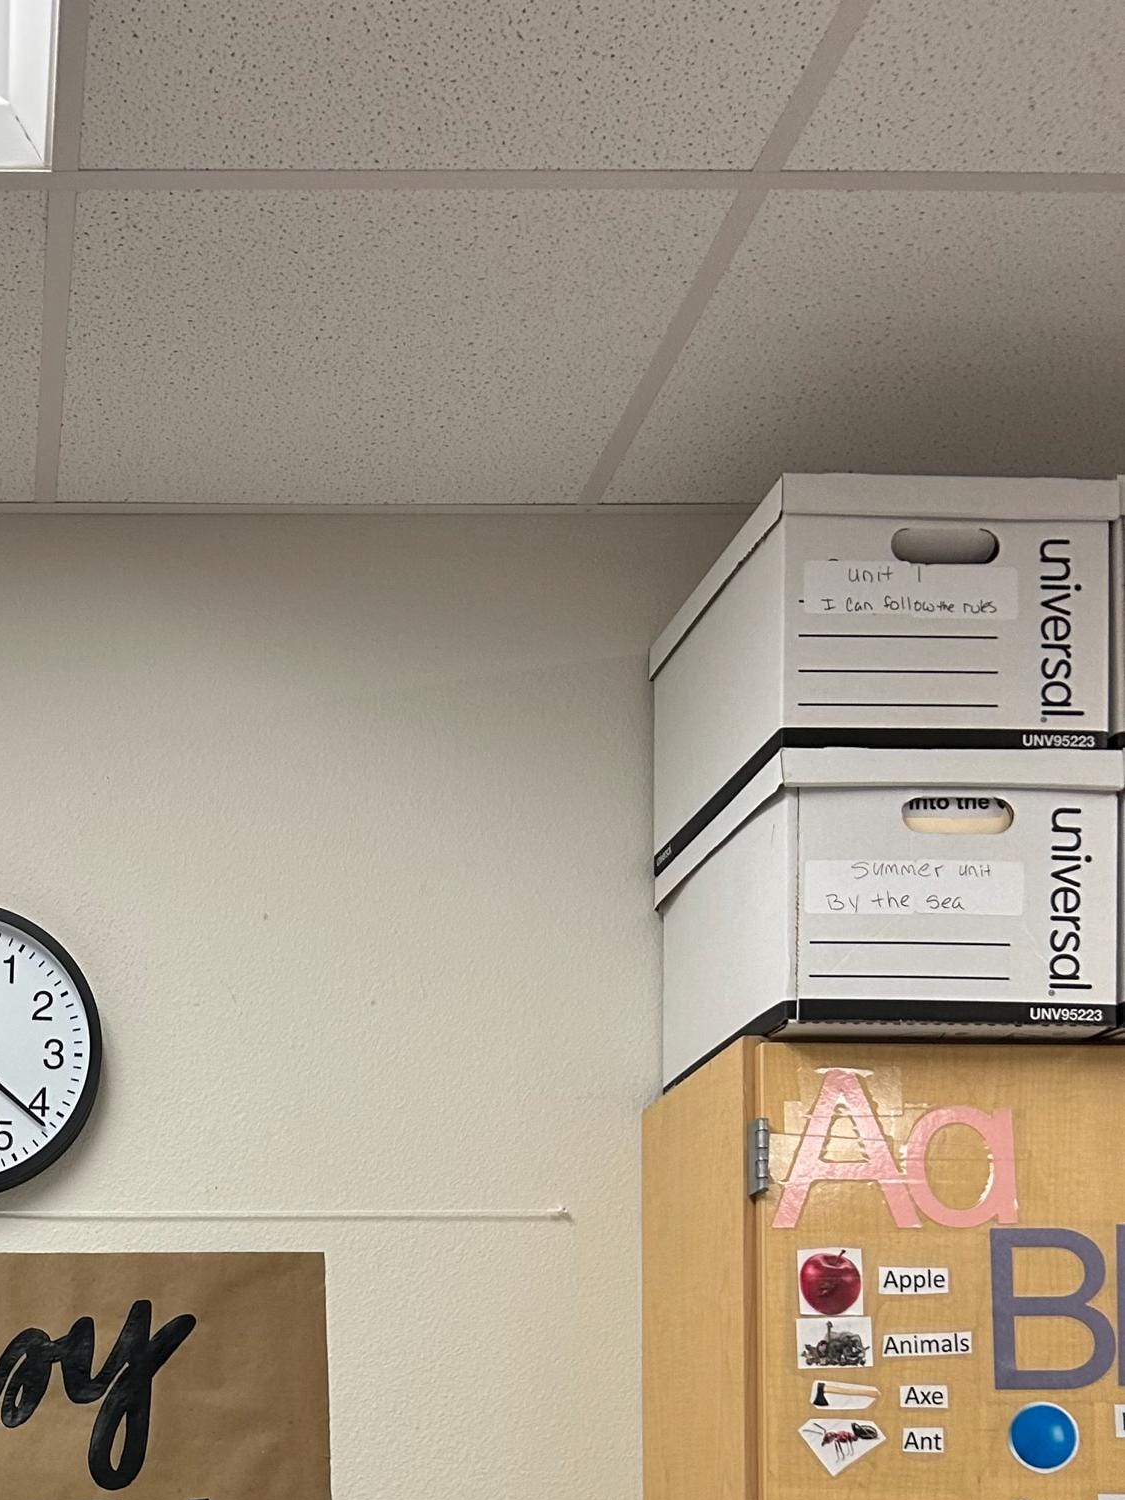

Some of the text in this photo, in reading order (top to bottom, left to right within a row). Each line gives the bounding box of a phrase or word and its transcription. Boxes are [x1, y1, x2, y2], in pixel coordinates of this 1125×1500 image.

[822, 599, 836, 612] I
[883, 595, 935, 613] follow
[935, 601, 955, 614] the
[1039, 539, 1085, 716] universal
[1022, 734, 1096, 748] UNV95223
[959, 862, 992, 877] unit
[825, 890, 966, 912] By the sea
[1049, 807, 1093, 990] universal
[3, 955, 15, 984] 1
[32, 991, 53, 1021] 2
[1029, 1007, 1103, 1022] UNV95223
[43, 1039, 64, 1070] 3
[28, 1087, 50, 1117] 4
[772, 1067, 1019, 1228] Aa
[883, 1269, 946, 1293] Apple
[989, 1228, 1125, 1390] B
[884, 1333, 970, 1356] Animals
[905, 1388, 944, 1405] Axe
[904, 1431, 942, 1450] Ant
